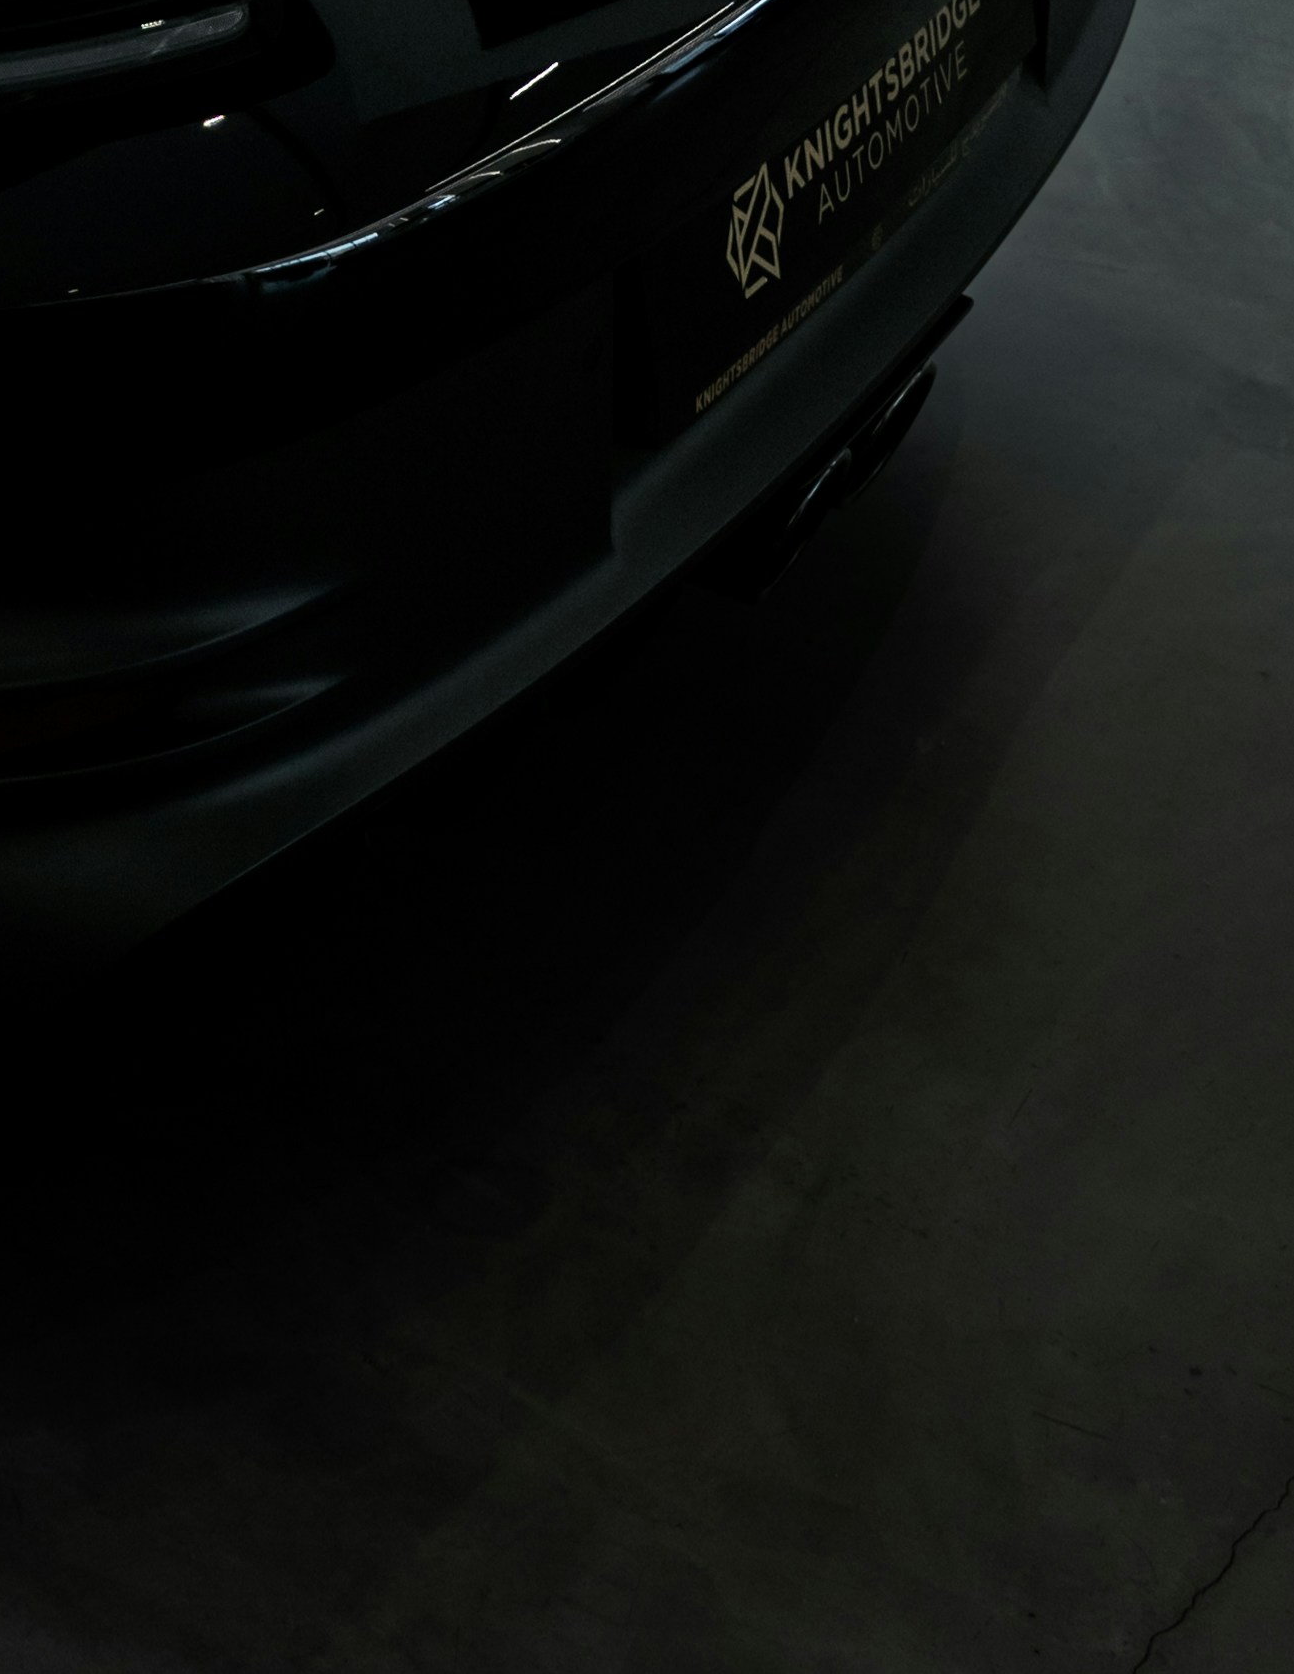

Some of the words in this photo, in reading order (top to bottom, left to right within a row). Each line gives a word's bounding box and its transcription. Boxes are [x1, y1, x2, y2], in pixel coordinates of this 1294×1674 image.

[818, 40, 968, 225] AUTOMOTIVE
[694, 327, 781, 415] KNIGHTSBRIDGE
[780, 263, 845, 337] AUTOMOTIVE
